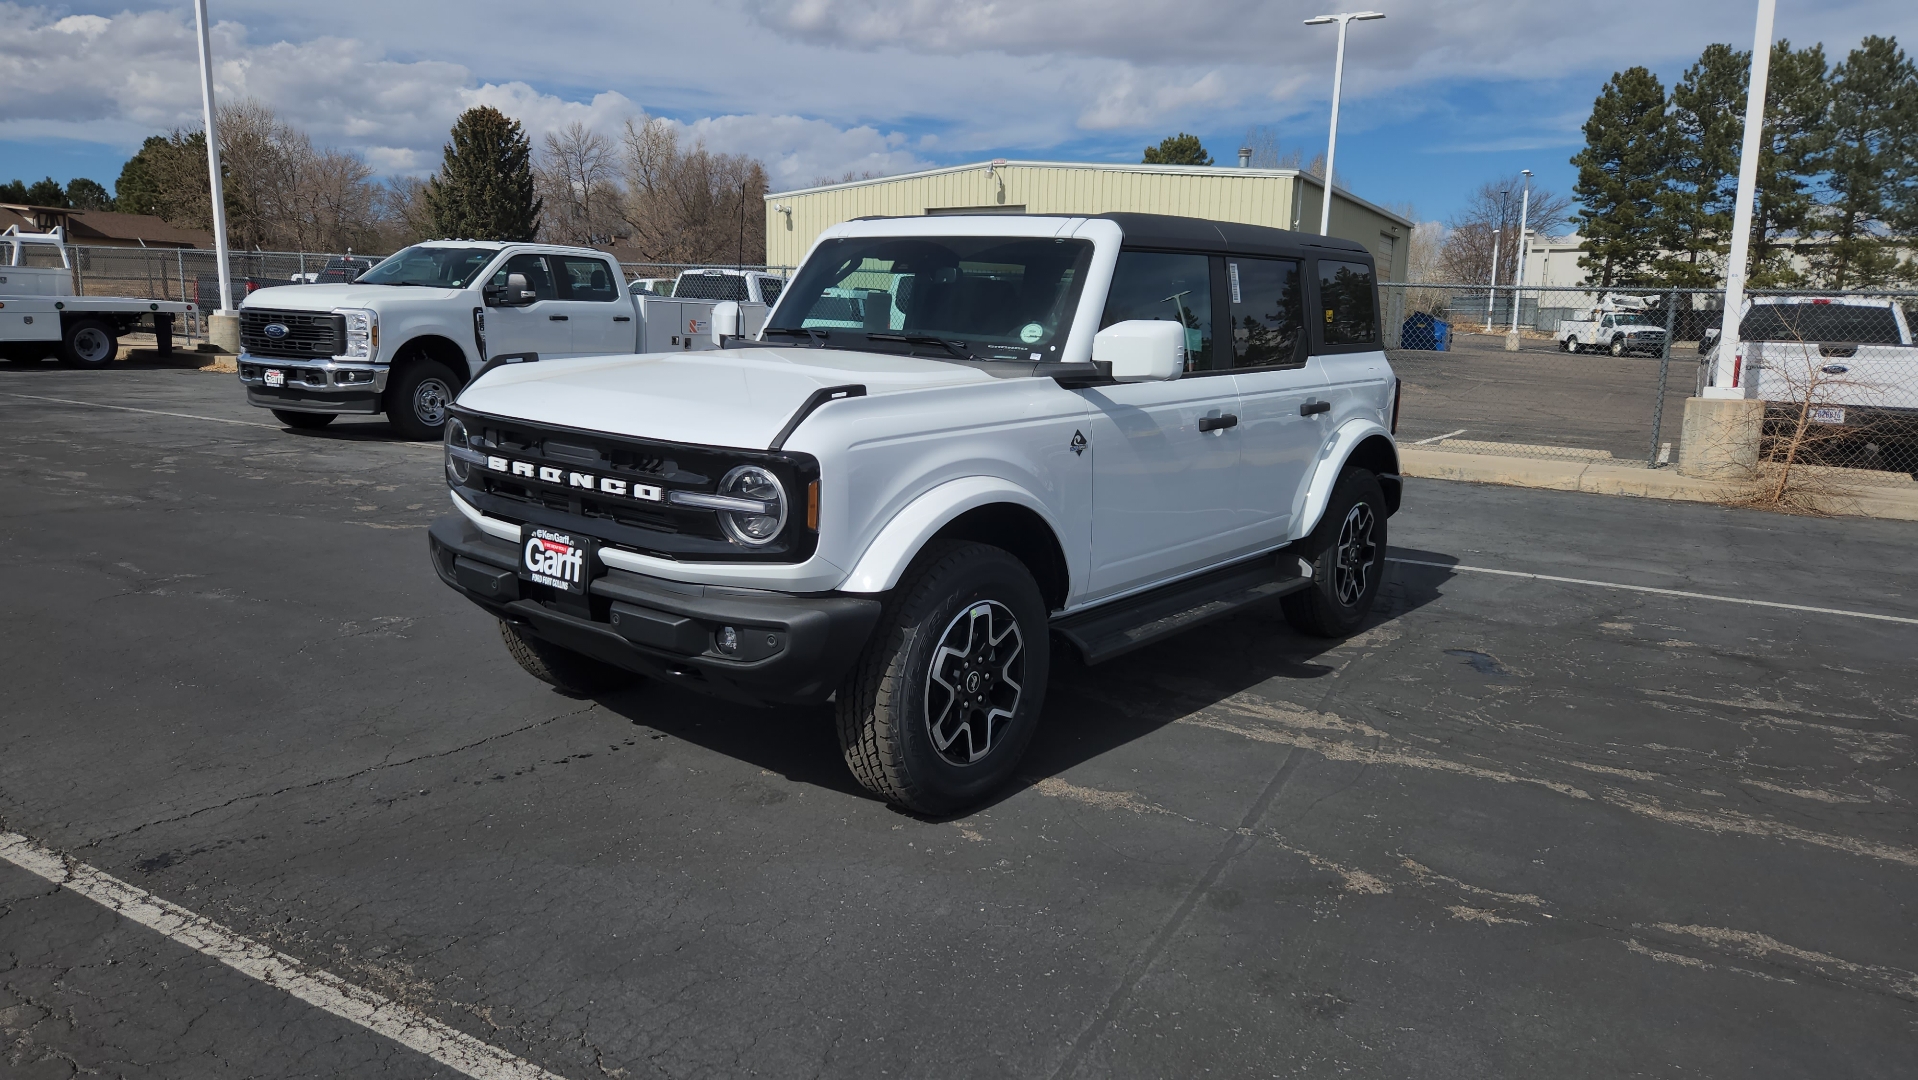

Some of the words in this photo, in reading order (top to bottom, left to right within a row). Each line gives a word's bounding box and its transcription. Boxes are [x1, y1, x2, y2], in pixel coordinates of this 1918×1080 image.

[488, 456, 662, 501] BRONCO
[525, 538, 582, 582] Garff
[531, 573, 542, 583] FORD
[552, 579, 568, 590] COLLINS
